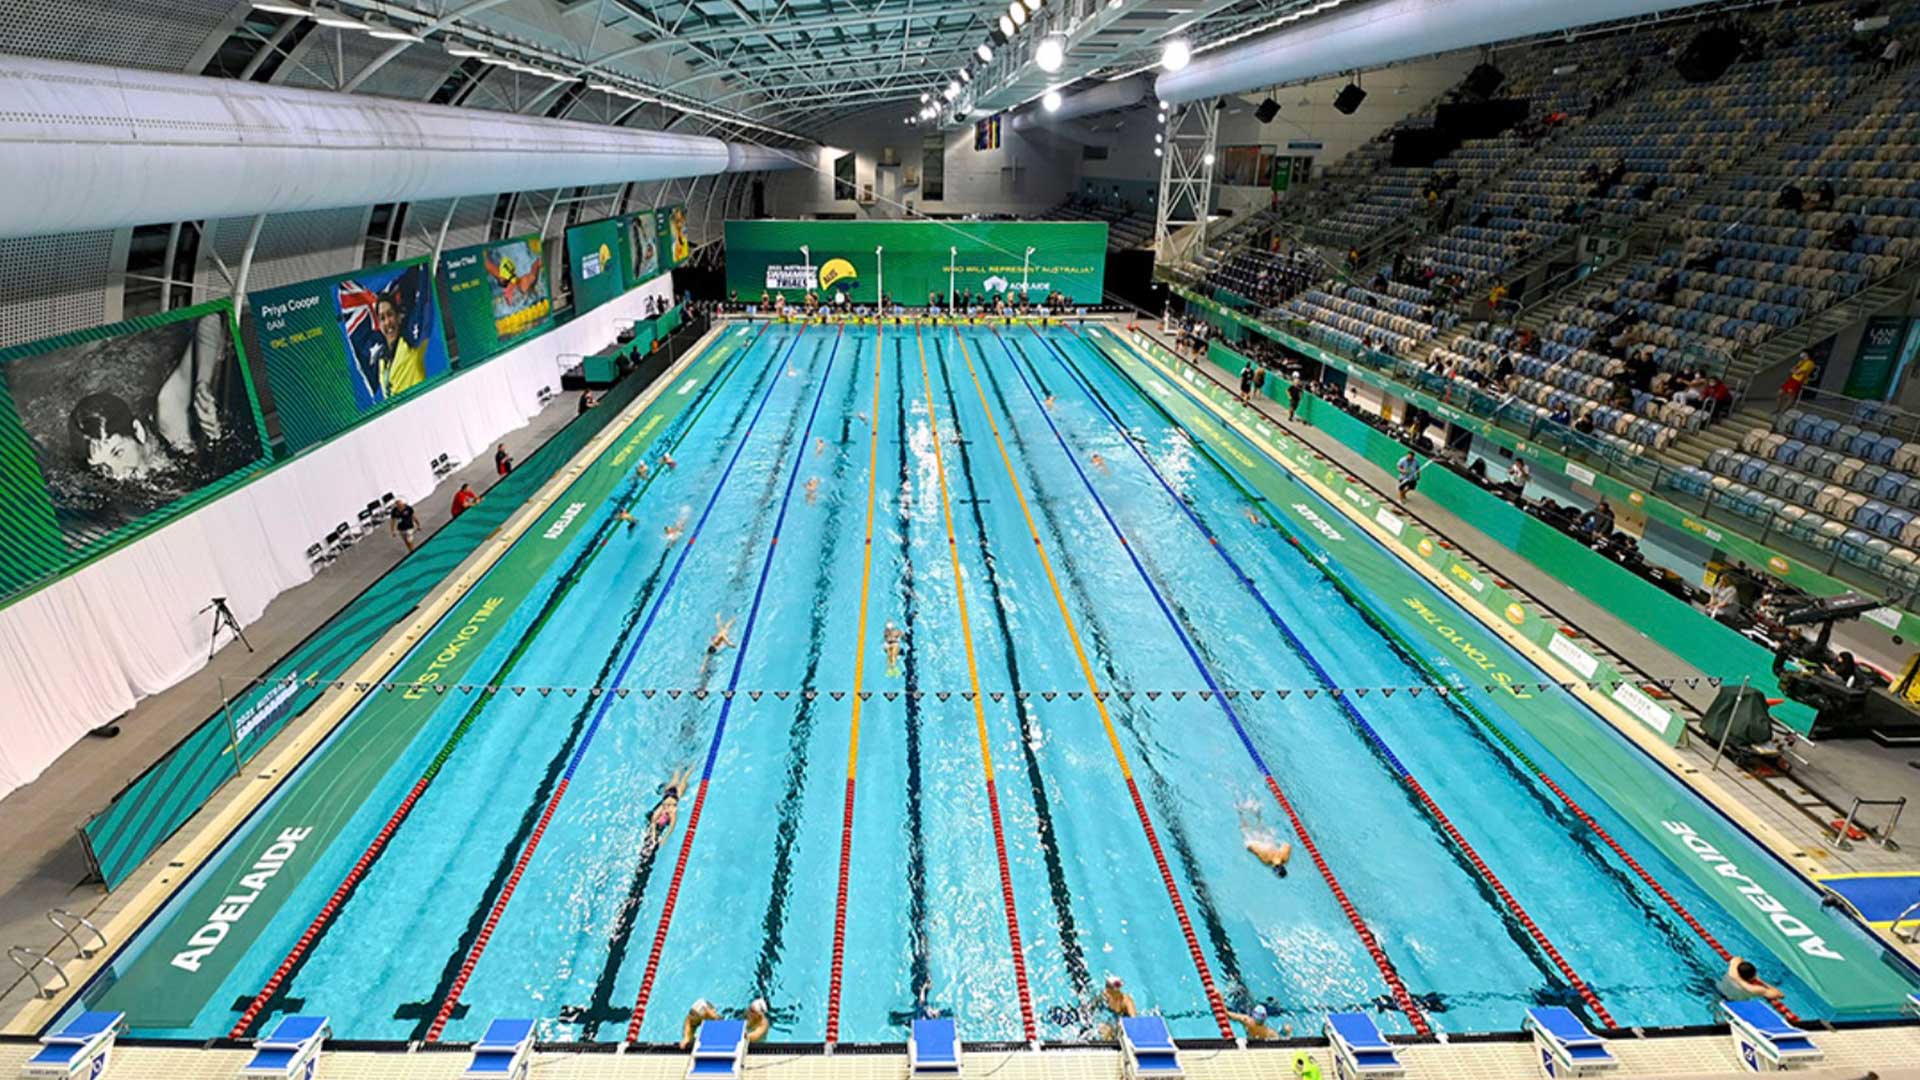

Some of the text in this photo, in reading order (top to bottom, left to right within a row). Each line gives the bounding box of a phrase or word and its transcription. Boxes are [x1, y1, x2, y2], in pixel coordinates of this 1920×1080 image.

[942, 265, 965, 273] WHO
[262, 296, 319, 318] Priya Cooper
[1402, 597, 1442, 624] TIME
[428, 624, 479, 671] TOKYO
[468, 597, 504, 624] TIME
[1436, 625, 1496, 670] TOKYO
[171, 826, 313, 973] ADELAIDE
[1661, 820, 1845, 961] ADELAIDE
